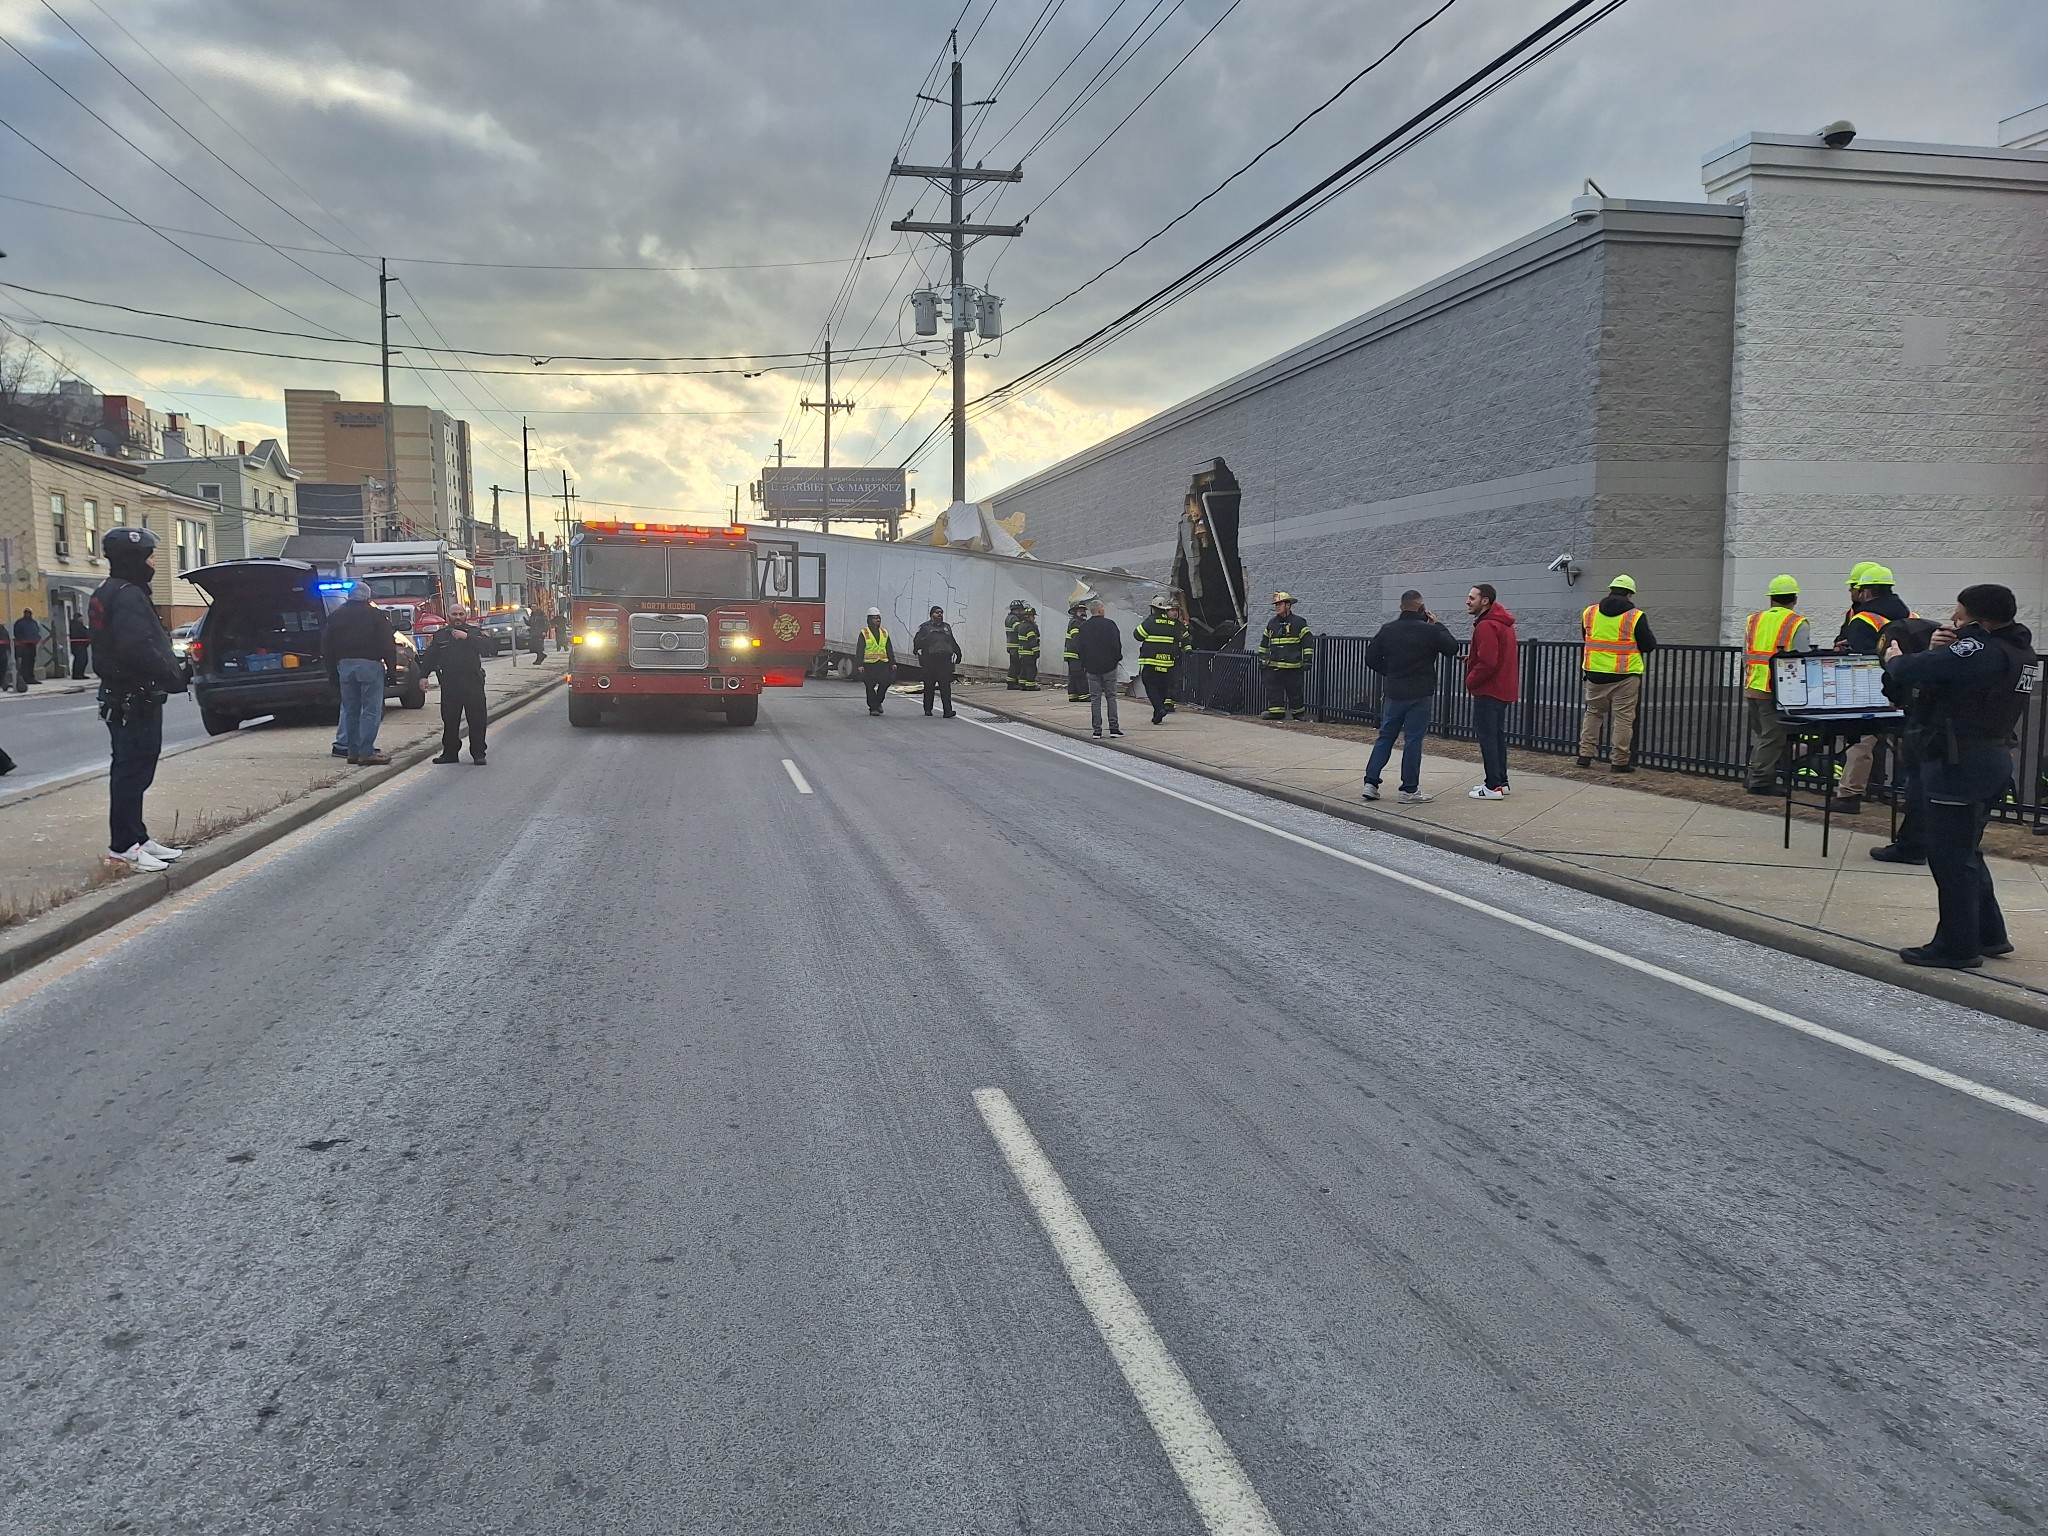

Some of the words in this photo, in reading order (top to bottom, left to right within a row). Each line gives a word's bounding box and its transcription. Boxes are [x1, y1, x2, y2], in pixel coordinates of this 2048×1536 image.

[837, 484, 845, 492] &
[848, 483, 902, 492] MARTINEZ
[641, 601, 666, 610] NORTH
[667, 602, 696, 611] HUDSON
